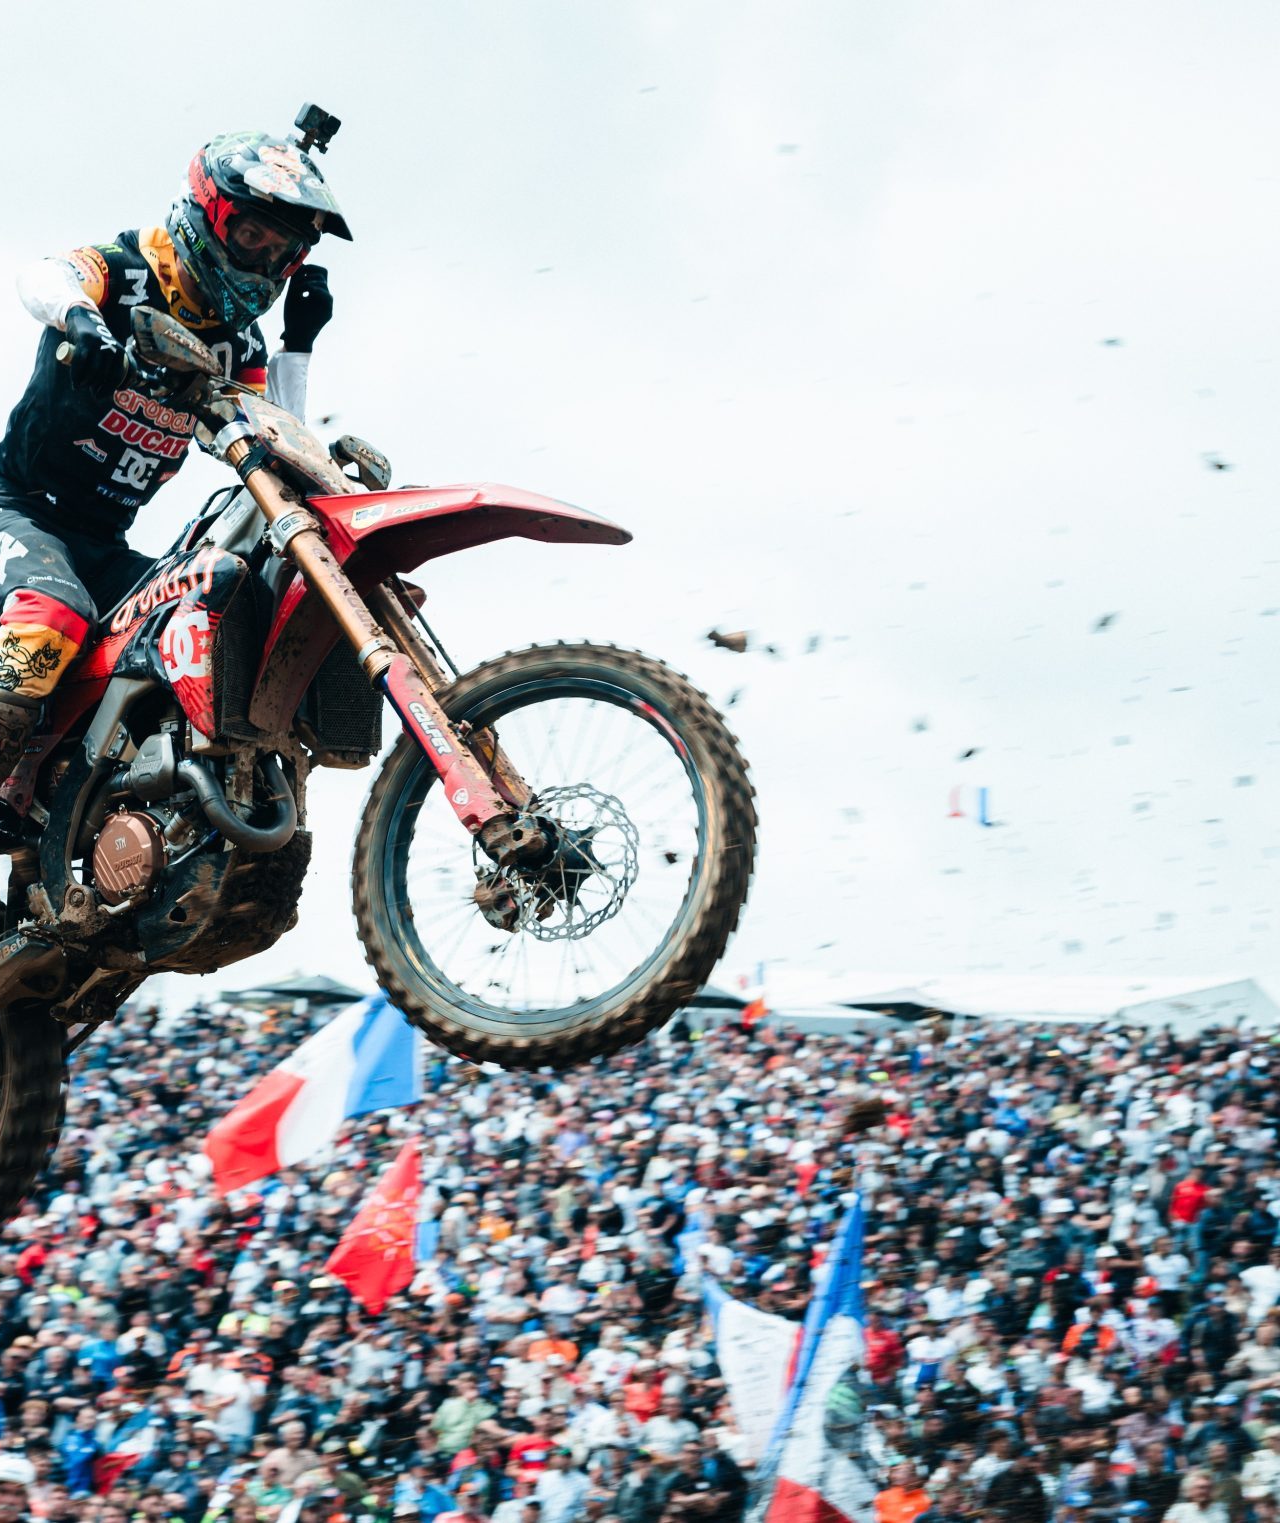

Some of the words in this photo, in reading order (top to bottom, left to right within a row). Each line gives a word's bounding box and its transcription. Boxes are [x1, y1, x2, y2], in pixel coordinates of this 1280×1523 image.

[193, 163, 220, 205] TISSOT
[98, 408, 193, 459] DUCAT
[113, 388, 198, 435] aruba.I
[408, 702, 453, 756] GALFER
[114, 852, 142, 875] DUCATI
